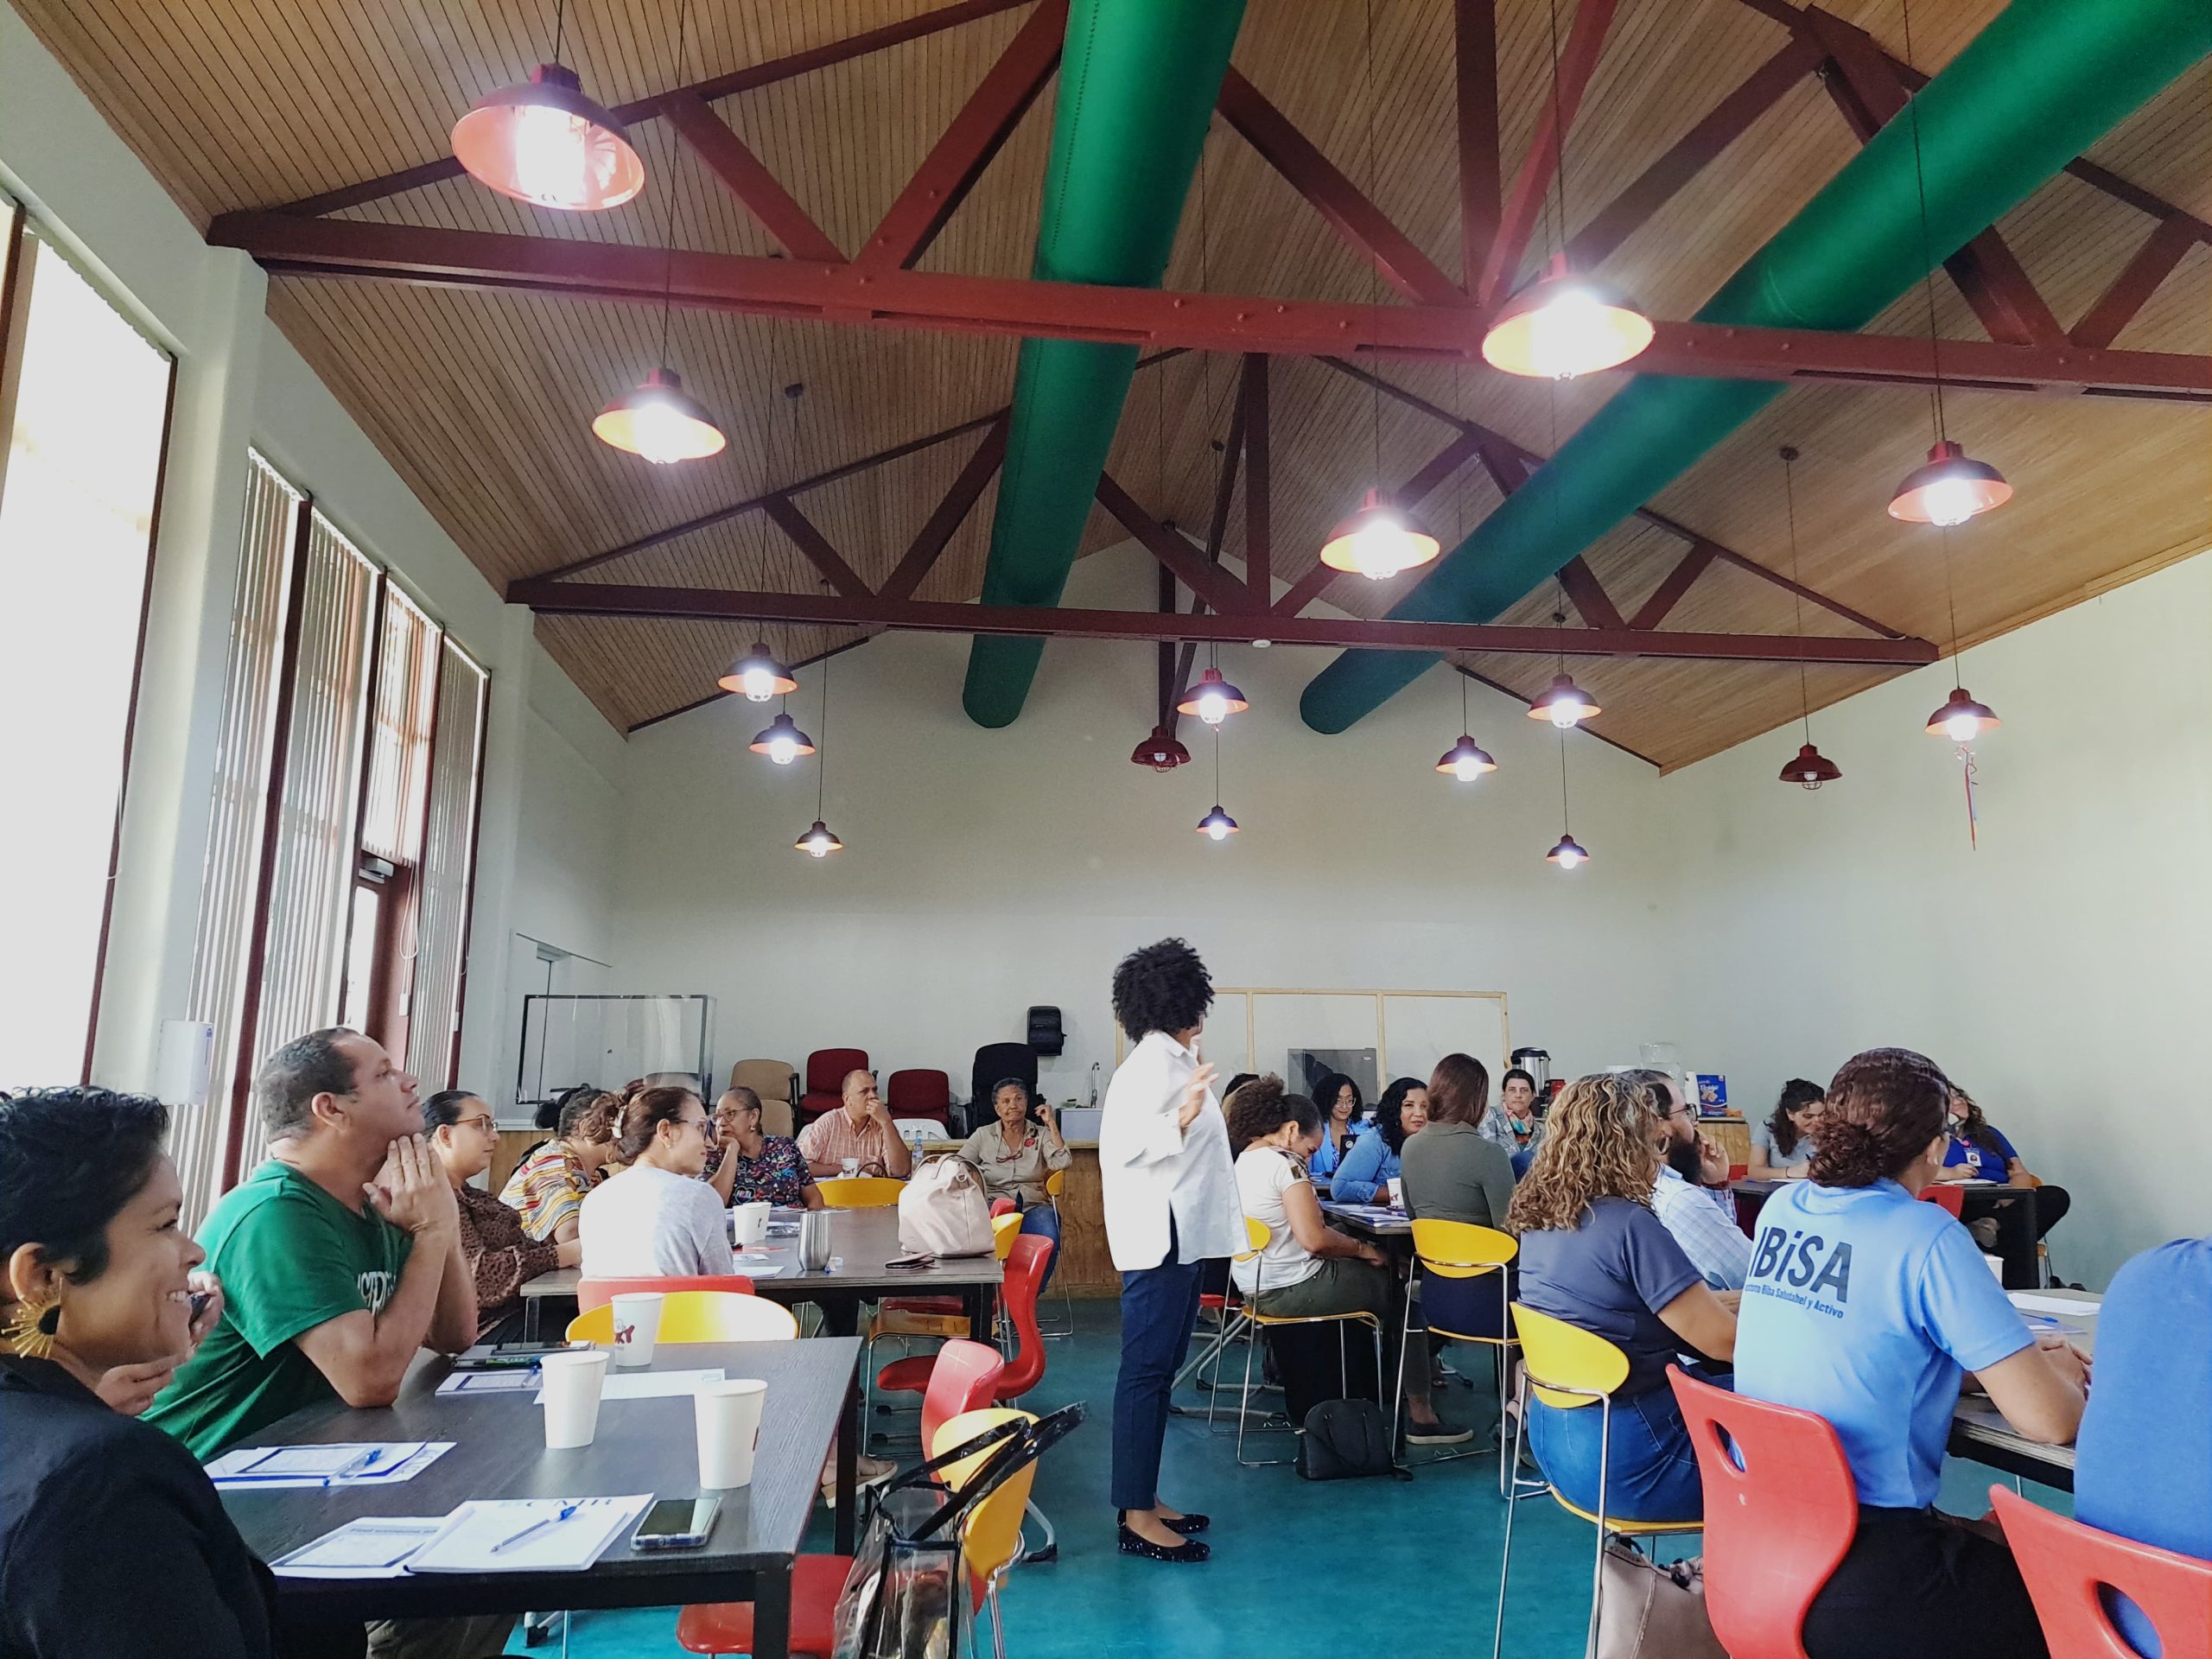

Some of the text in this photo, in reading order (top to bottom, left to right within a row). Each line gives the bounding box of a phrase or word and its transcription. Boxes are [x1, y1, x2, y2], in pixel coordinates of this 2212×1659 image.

[1749, 1226, 1852, 1303] IBiSA
[1807, 1300, 1813, 1309] y
[1814, 1300, 1844, 1319] Activo
